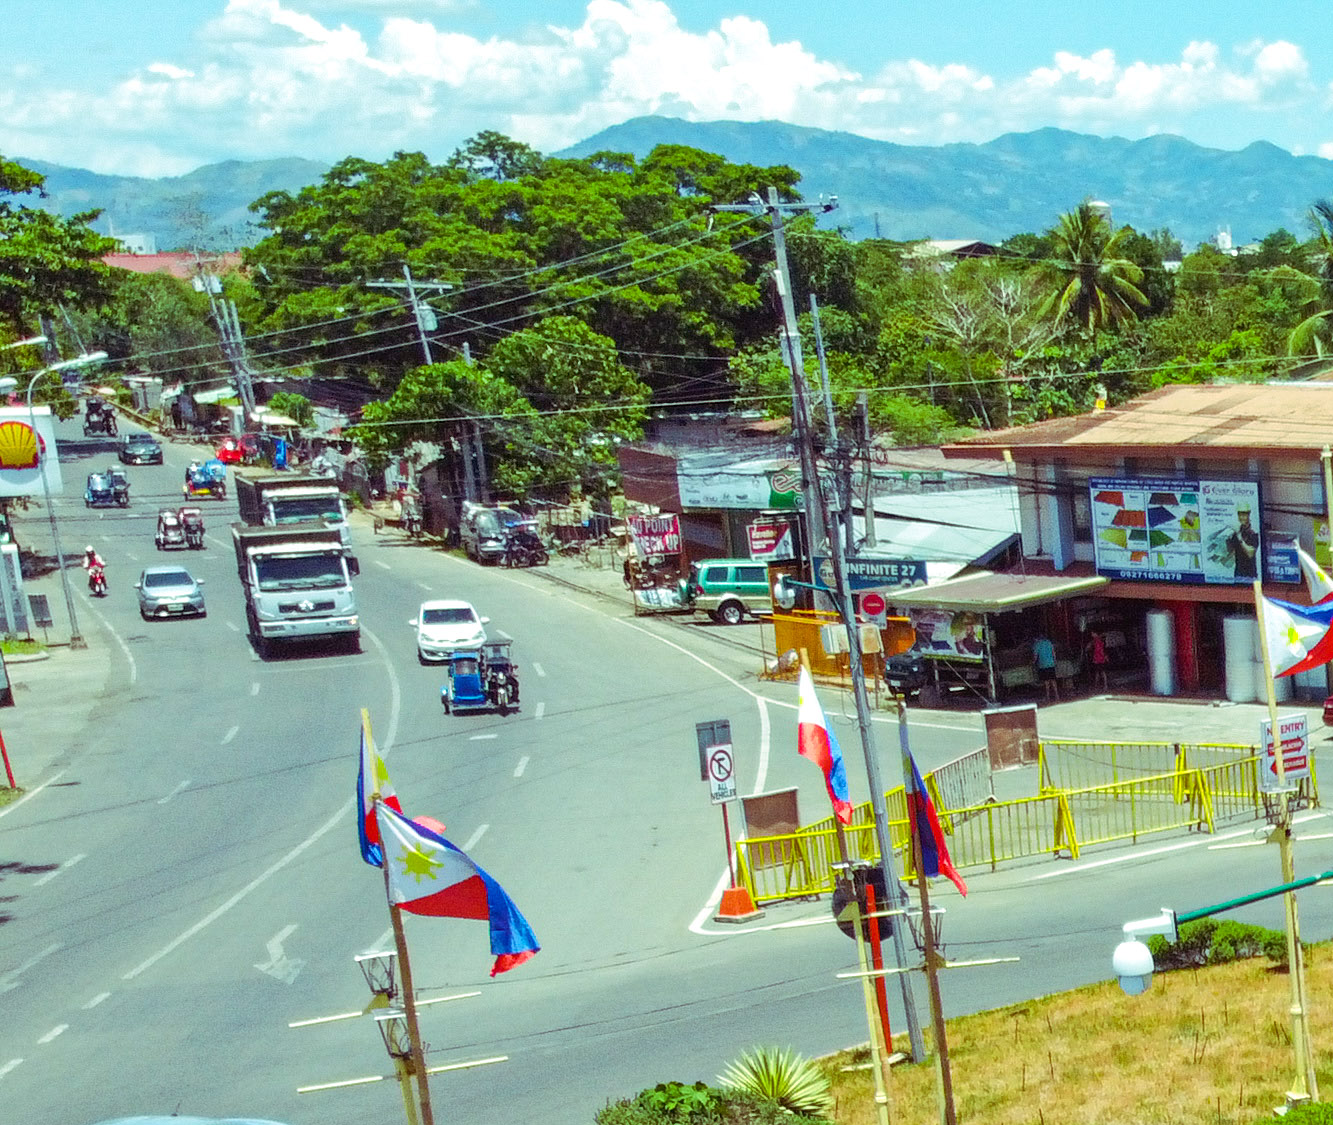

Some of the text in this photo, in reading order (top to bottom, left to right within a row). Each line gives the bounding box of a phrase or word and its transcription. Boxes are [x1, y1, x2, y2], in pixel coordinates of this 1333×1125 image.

[847, 563, 916, 576] INFINITE 27
[1280, 722, 1305, 735] ENTRY
